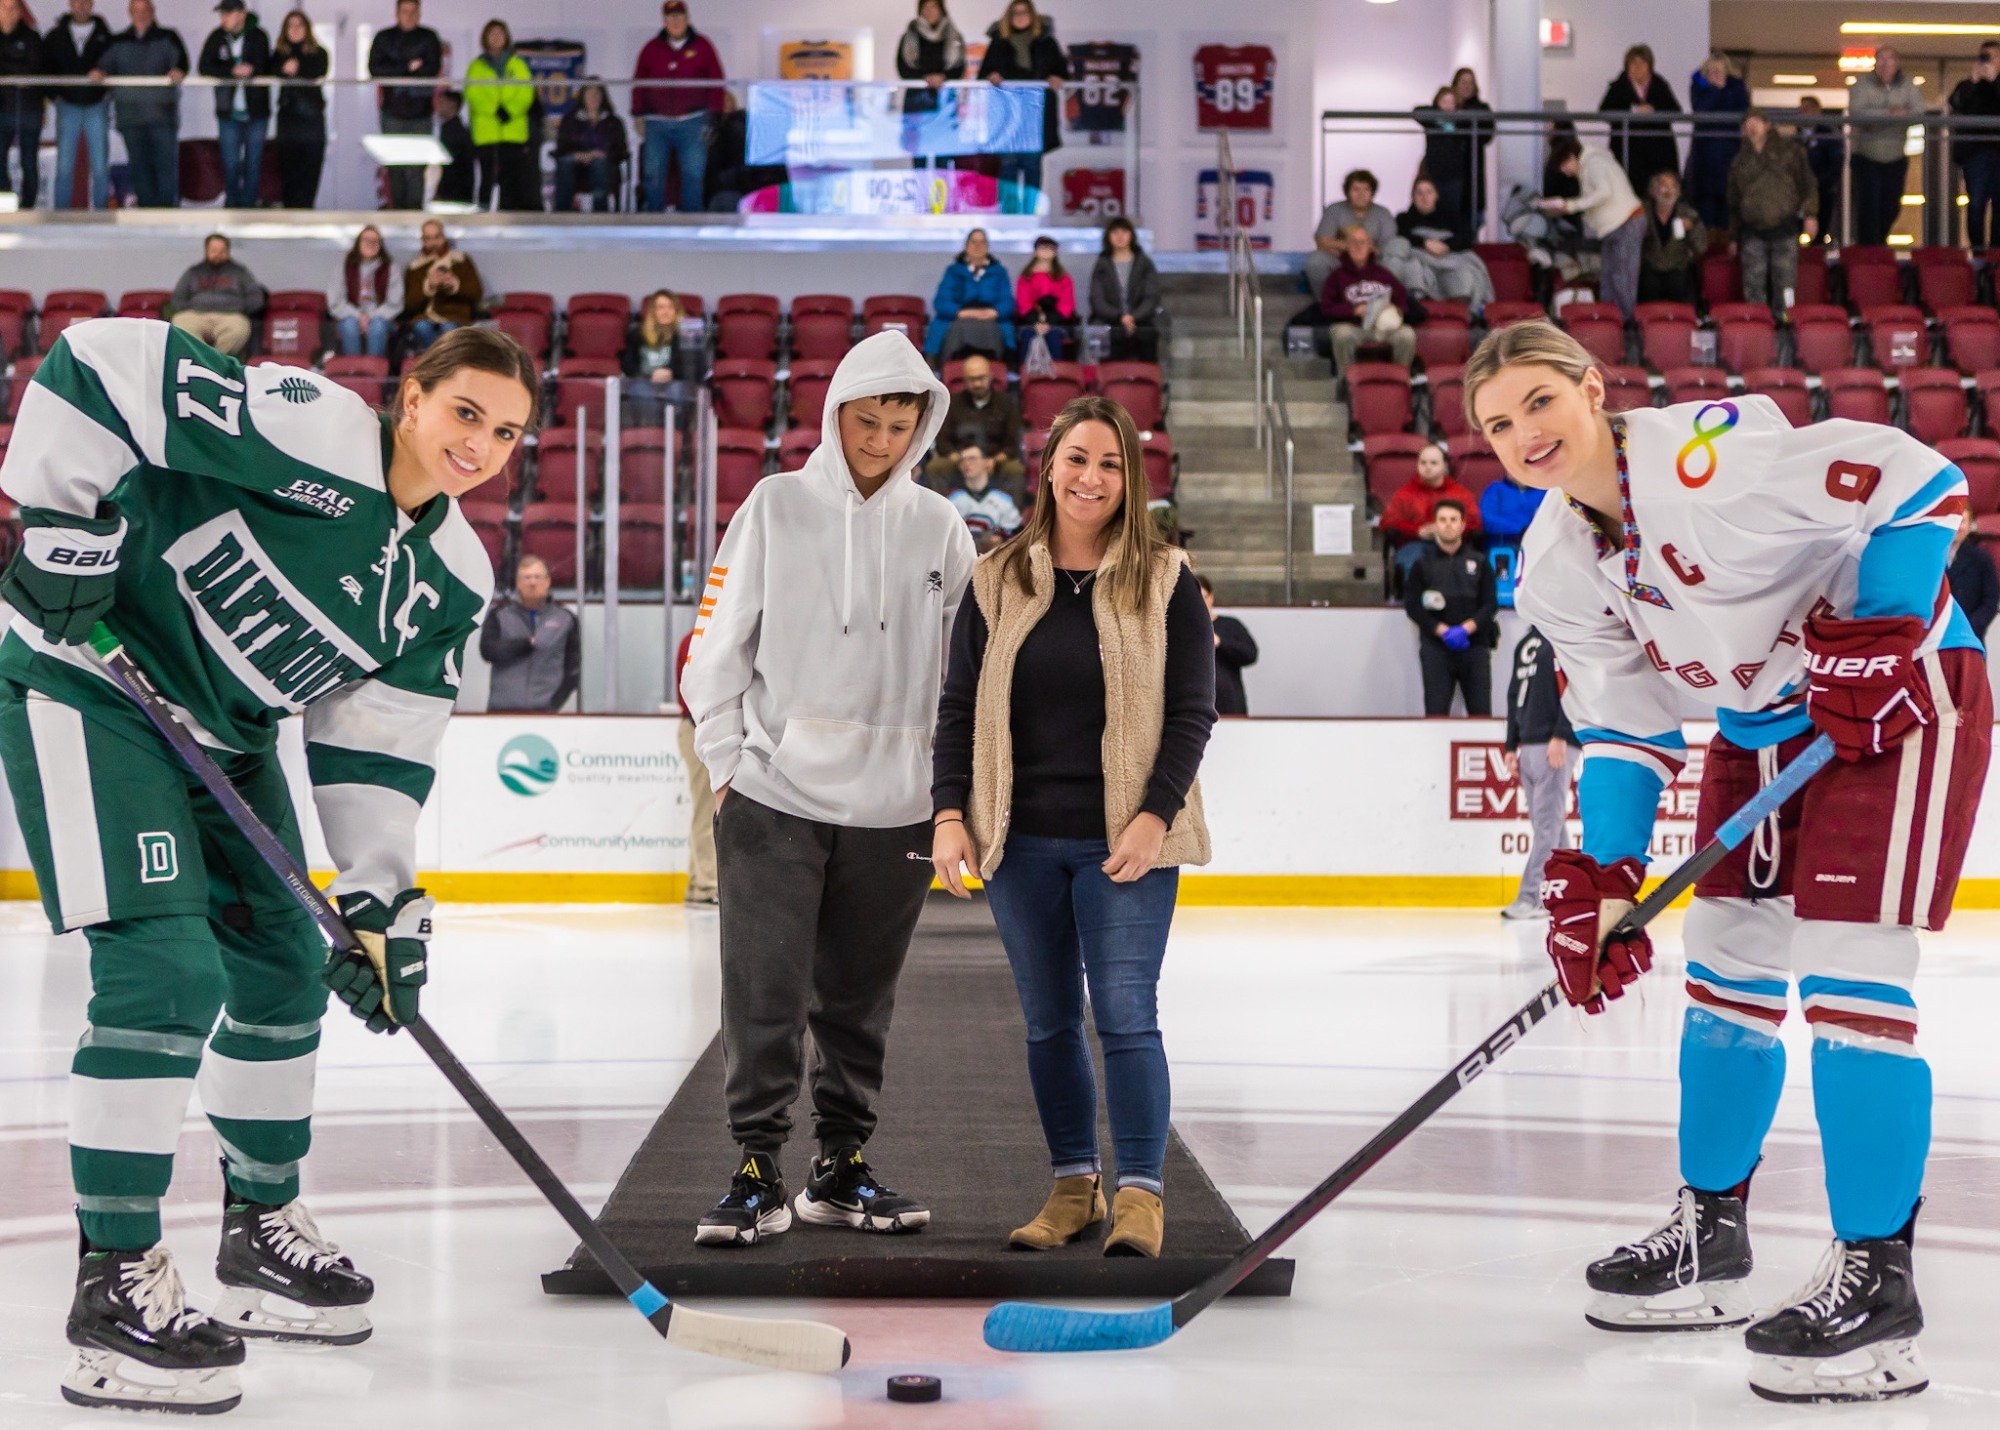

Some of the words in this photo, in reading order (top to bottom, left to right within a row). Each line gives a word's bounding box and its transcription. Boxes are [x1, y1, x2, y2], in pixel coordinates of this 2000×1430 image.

[1216, 78, 1255, 113] 89
[176, 358, 246, 437] 17
[288, 479, 356, 512] ECAC
[289, 492, 346, 519] HOCKEY
[1660, 542, 1706, 587] C
[392, 581, 441, 641] C
[566, 749, 681, 774] Community
[568, 773, 612, 785] Quality
[137, 831, 179, 884] D
[286, 871, 325, 916] TRIGGER
[258, 1265, 292, 1287] BAUER
